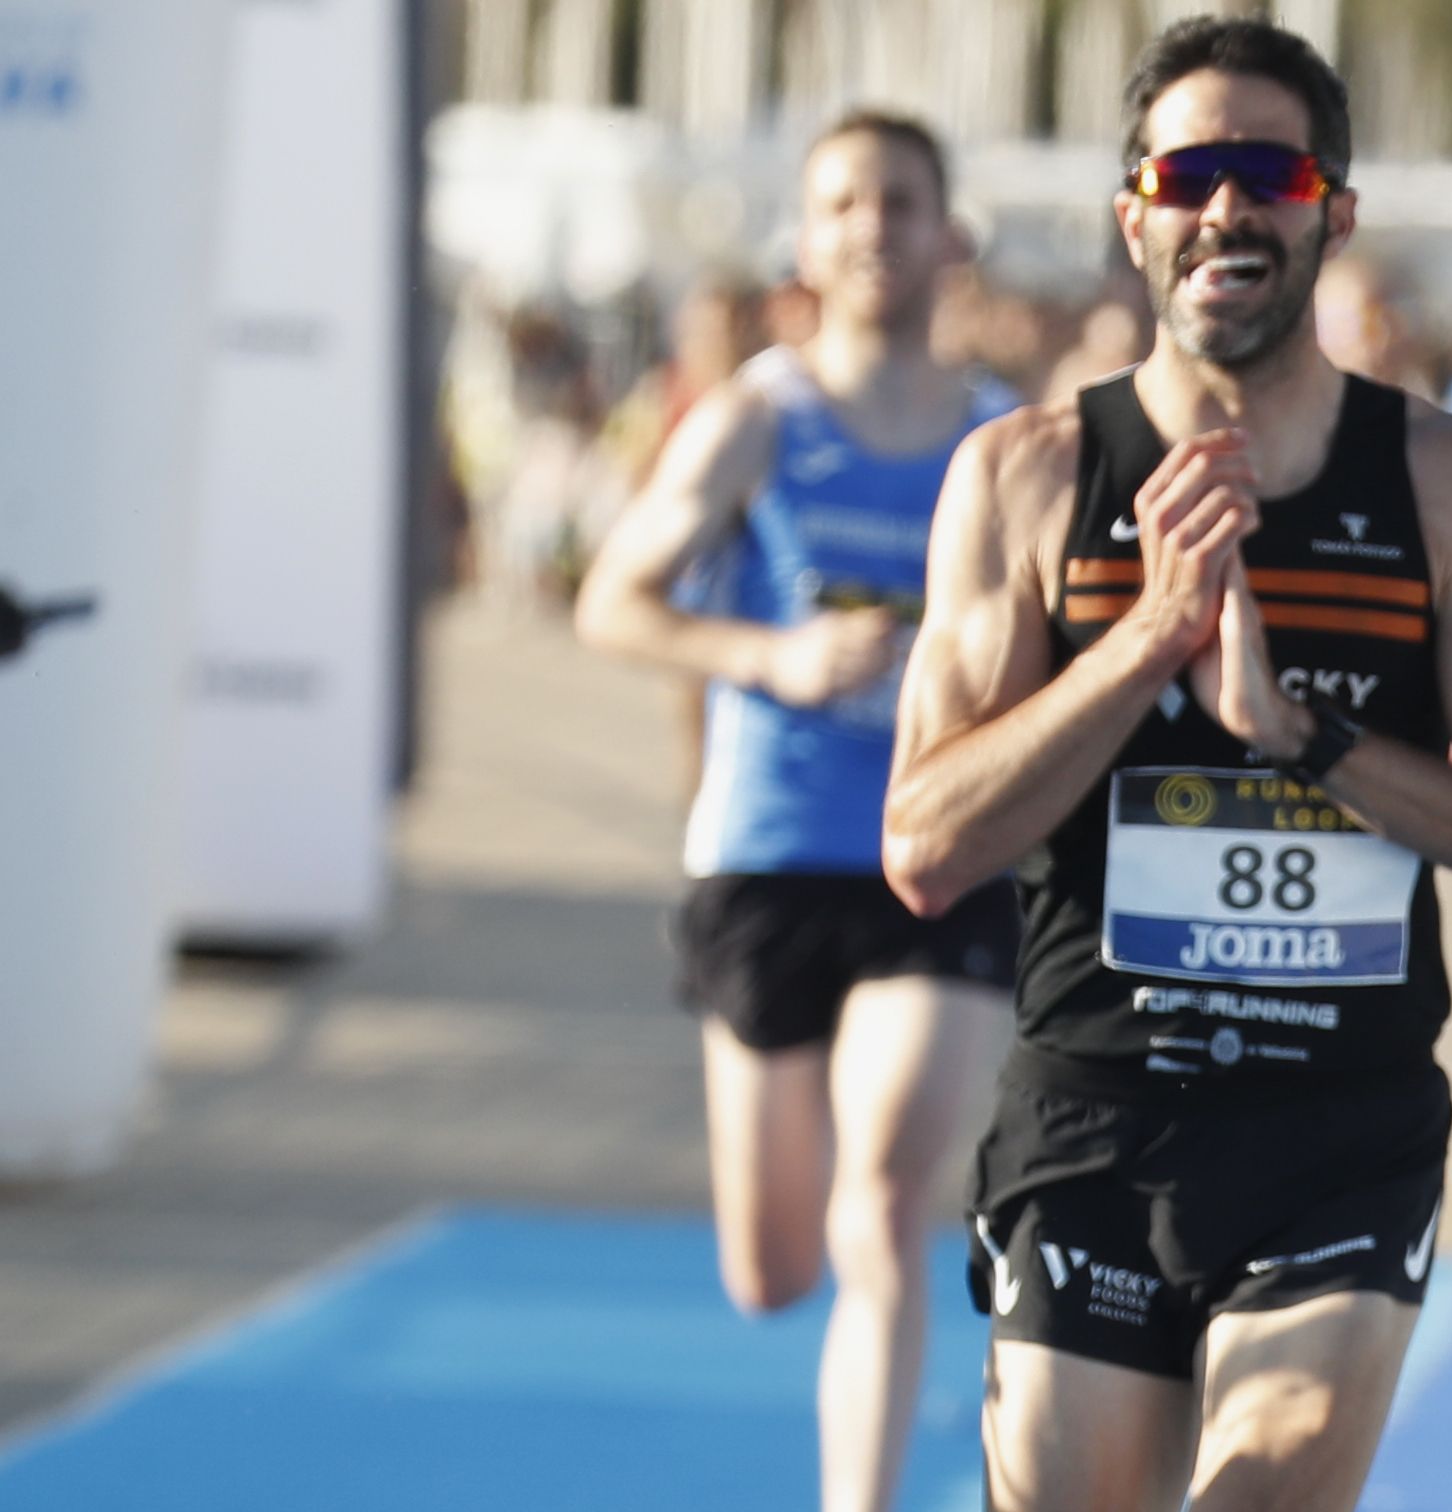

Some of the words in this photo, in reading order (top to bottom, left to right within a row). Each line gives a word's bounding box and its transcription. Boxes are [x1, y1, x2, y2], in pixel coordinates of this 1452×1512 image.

[1278, 665, 1378, 708] CKY
[1219, 845, 1318, 912] 88
[1089, 1262, 1161, 1297] VICKY
